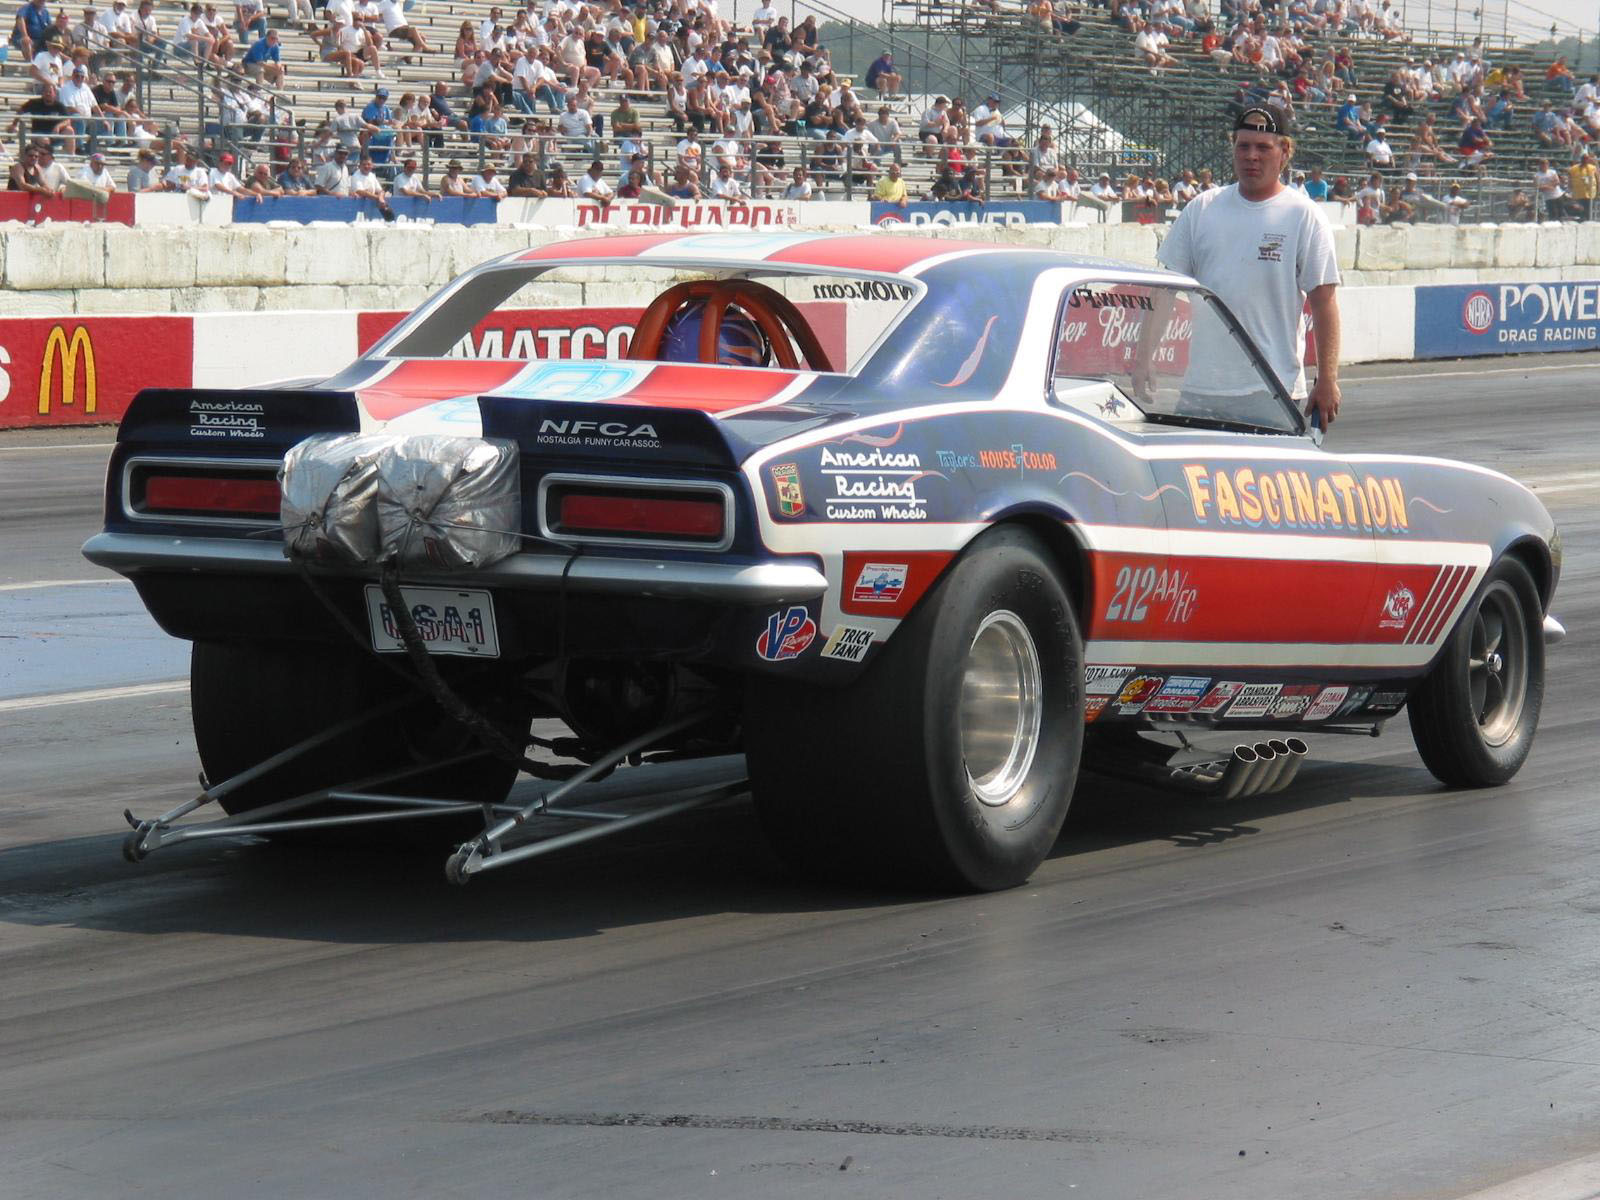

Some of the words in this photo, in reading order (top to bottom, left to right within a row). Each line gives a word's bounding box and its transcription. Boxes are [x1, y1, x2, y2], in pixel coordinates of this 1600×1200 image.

[1468, 298, 1491, 328] NHRA
[1500, 284, 1600, 325] POWE
[447, 325, 636, 360] MATCO
[1499, 329, 1537, 342] DRAG
[1544, 326, 1597, 341] RACING
[190, 400, 264, 411] American
[199, 414, 257, 431] Racing
[539, 419, 658, 438] NFCA
[190, 428, 226, 437] Custom
[229, 429, 264, 438] Wheels
[537, 435, 581, 445] NOSTALGIA
[584, 437, 611, 446] FUNNY
[613, 439, 631, 447] CAR
[632, 440, 662, 449] ASSOC.
[820, 447, 921, 467] American
[979, 450, 1017, 469] HOUSE
[1023, 451, 1057, 470] COLOR
[834, 475, 916, 508] Racing
[1183, 464, 1410, 533] FASCINATION
[826, 505, 877, 519] Custom
[880, 505, 928, 520] Wheels
[1104, 566, 1156, 622] 212
[765, 606, 808, 660] VP
[840, 628, 874, 645] TRICK
[830, 643, 864, 660] TANK
